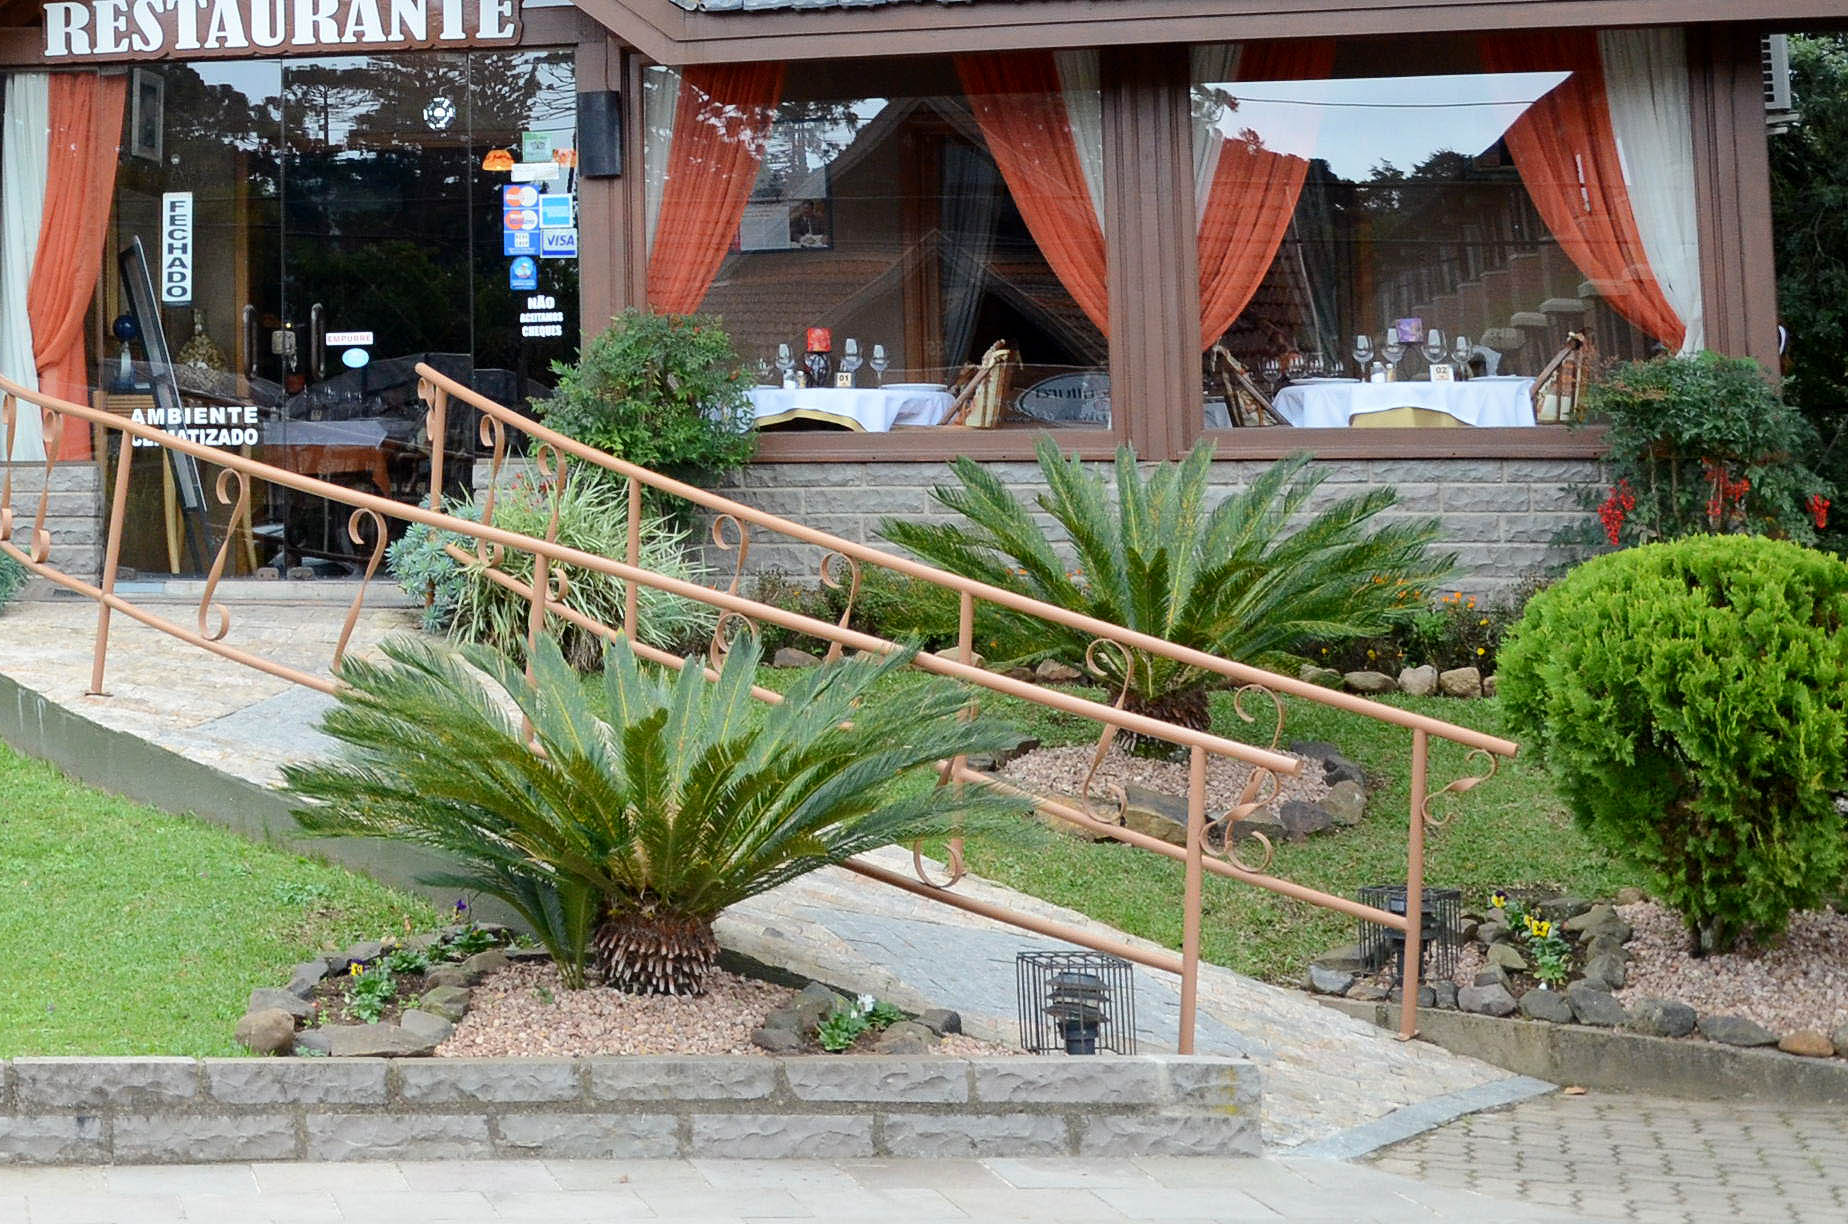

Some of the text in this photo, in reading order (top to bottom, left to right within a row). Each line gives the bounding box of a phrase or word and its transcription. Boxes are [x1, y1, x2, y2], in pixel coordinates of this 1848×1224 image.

[547, 235, 575, 246] VISA
[166, 200, 188, 297] FECHADO
[527, 295, 555, 309] NÃO
[522, 325, 563, 337] CHEQUES
[131, 406, 258, 425] AMBIENTE
